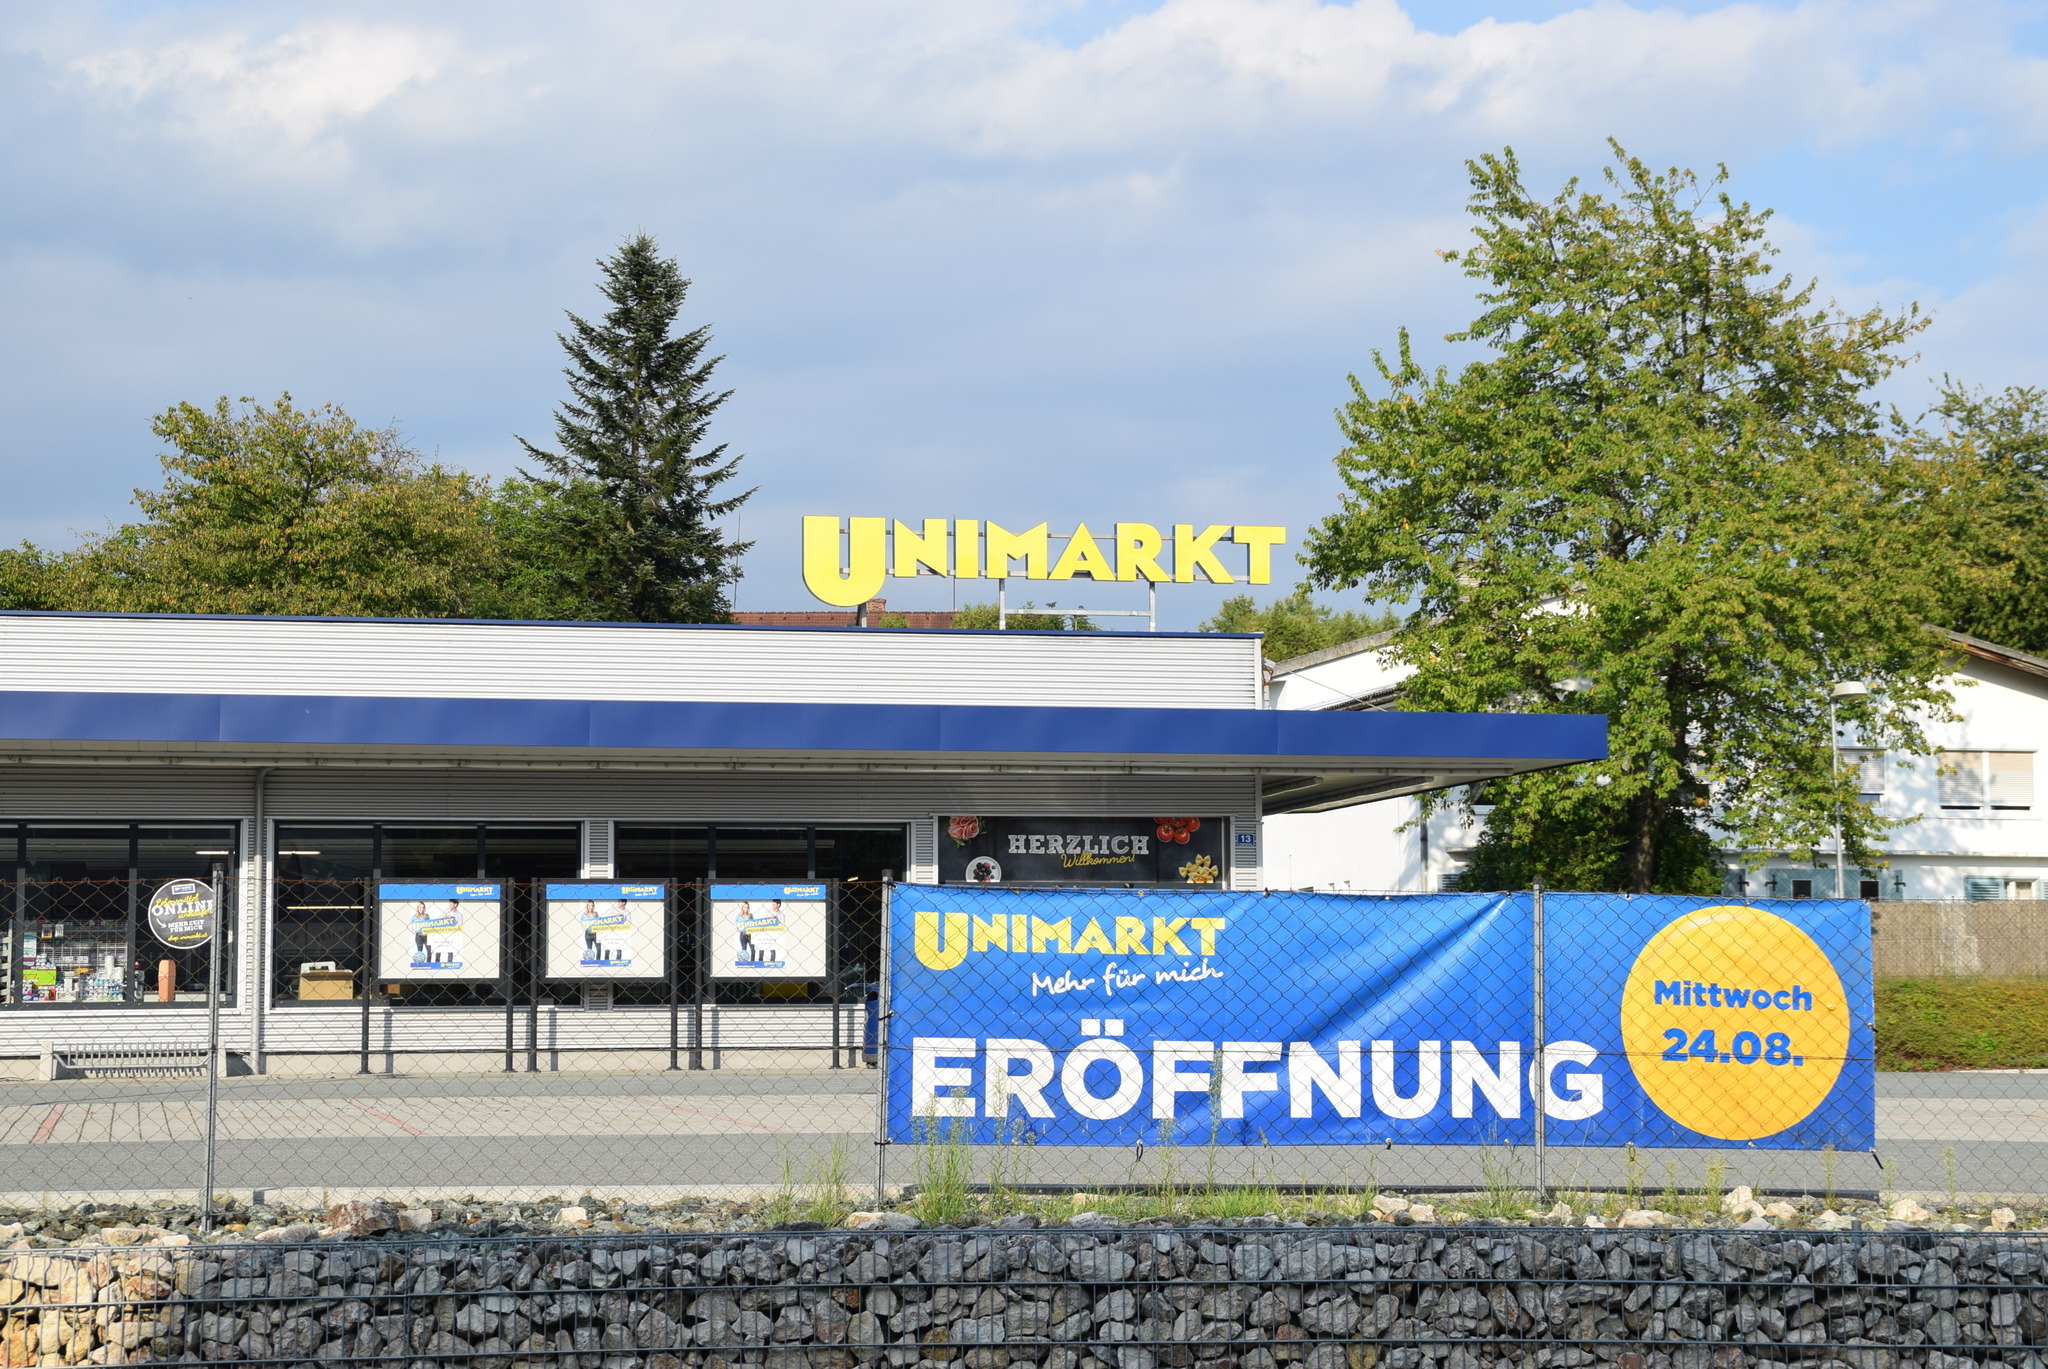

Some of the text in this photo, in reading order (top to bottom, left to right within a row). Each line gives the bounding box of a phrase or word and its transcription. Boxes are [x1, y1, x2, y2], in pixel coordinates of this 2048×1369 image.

[802, 515, 1287, 607] UNIMARKT
[1008, 834, 1149, 855] HERZLICH
[1240, 835, 1251, 843] 13
[1060, 849, 1136, 868] Willkommen!
[456, 886, 493, 894] UNIMARKT
[622, 886, 658, 894] UNIMARKT
[914, 911, 1226, 971] UNIMARKT
[1032, 957, 1224, 997] Mehr für mich
[1654, 980, 1812, 1011] Mittwoch
[1661, 1027, 1804, 1067] 24.08.
[911, 1018, 1604, 1121] ERÖFFNUNG
